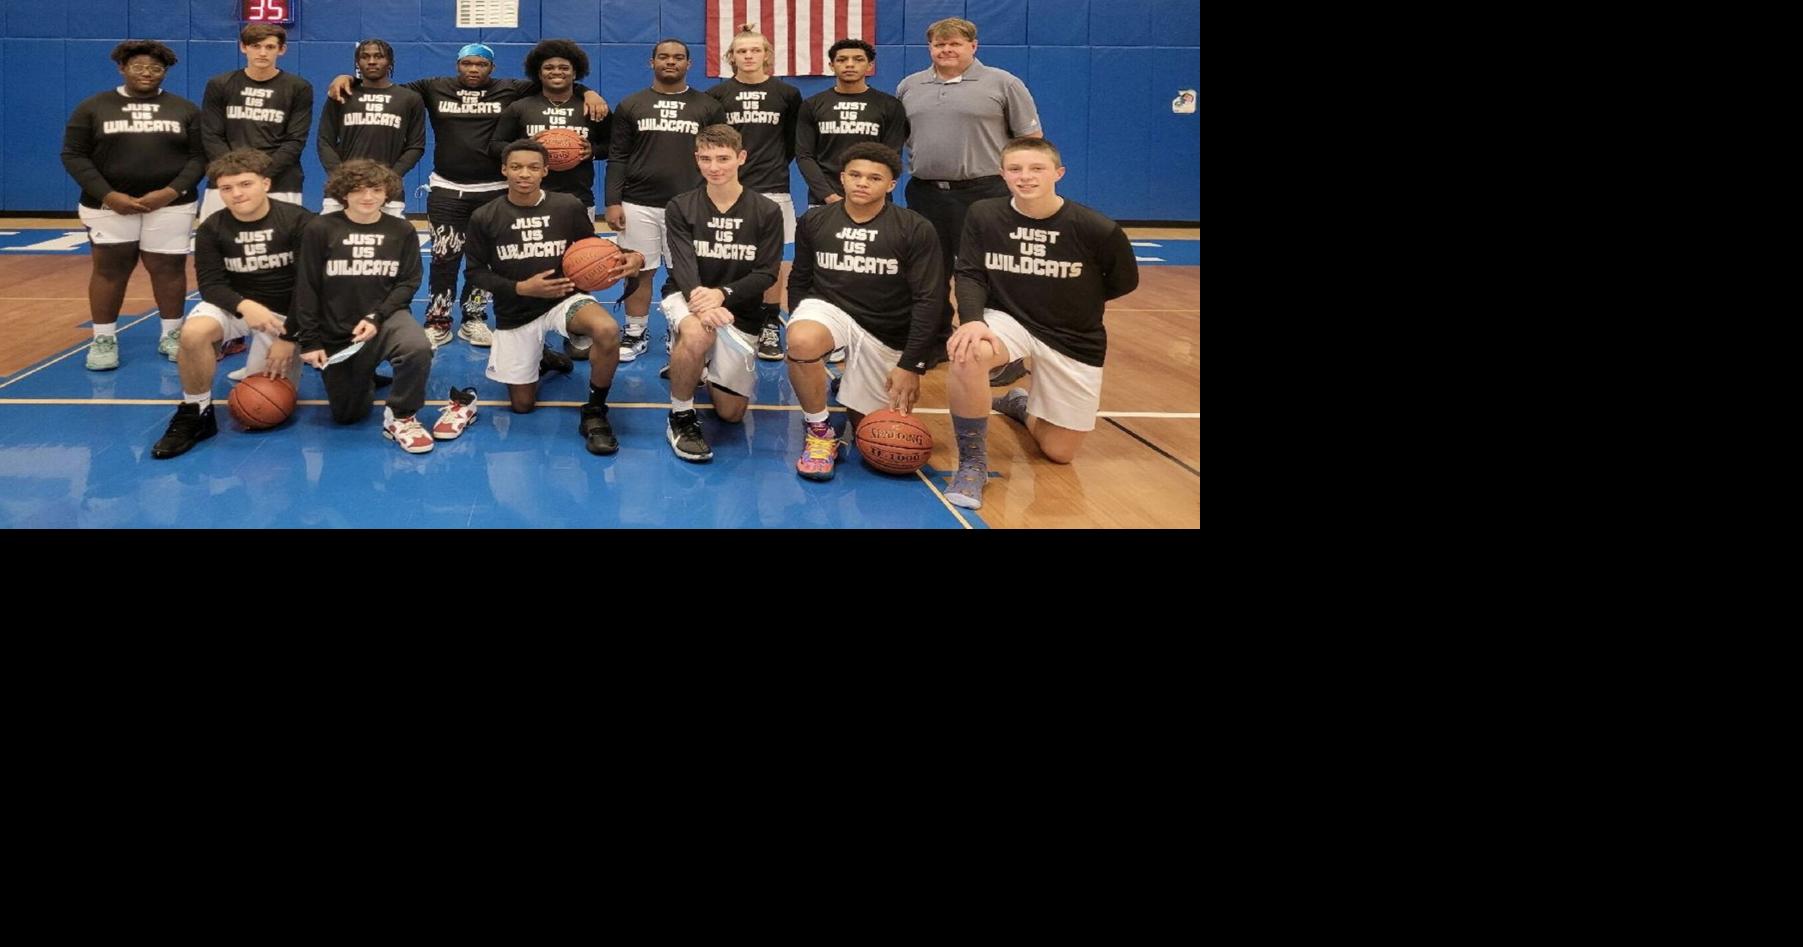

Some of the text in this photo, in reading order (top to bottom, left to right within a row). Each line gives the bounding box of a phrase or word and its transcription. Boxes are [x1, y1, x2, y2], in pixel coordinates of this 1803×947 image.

[249, 0, 282, 20] 35
[241, 87, 274, 98] JUST
[456, 90, 488, 98] JUST
[735, 91, 767, 100] JUST
[245, 98, 263, 107] US
[358, 94, 392, 104] JUST
[462, 96, 479, 104] US
[653, 100, 686, 110] JUST
[121, 103, 161, 112] JUST
[365, 103, 384, 112] US
[438, 100, 502, 114] WILDCATS
[743, 101, 759, 110] US
[833, 102, 867, 110] JUST
[131, 111, 153, 120] US
[226, 106, 285, 123] WILDCATS
[542, 108, 574, 117] JUST
[660, 109, 677, 119] US
[727, 111, 780, 124] WILDCATS
[840, 111, 857, 120] US
[103, 119, 181, 134] WILDCATS
[343, 112, 402, 129] WILDCATS
[549, 116, 566, 125] US
[637, 117, 700, 135] WILDCATS
[526, 124, 590, 139] WILTS
[819, 121, 879, 135] WILDCATS
[511, 216, 550, 229] JUST
[707, 217, 743, 229] JUST
[235, 229, 273, 243] JUST
[343, 233, 384, 245] JUST
[522, 230, 543, 241] US
[715, 230, 733, 242] US
[835, 227, 878, 242] JUST
[1009, 226, 1060, 243] JUST
[244, 243, 267, 256] US
[352, 247, 374, 258] US
[843, 241, 866, 254] US
[1020, 242, 1046, 257] US
[327, 260, 399, 276] WILDCATS
[815, 251, 899, 275] WILDCATS
[984, 252, 1083, 279] WILDCATS
